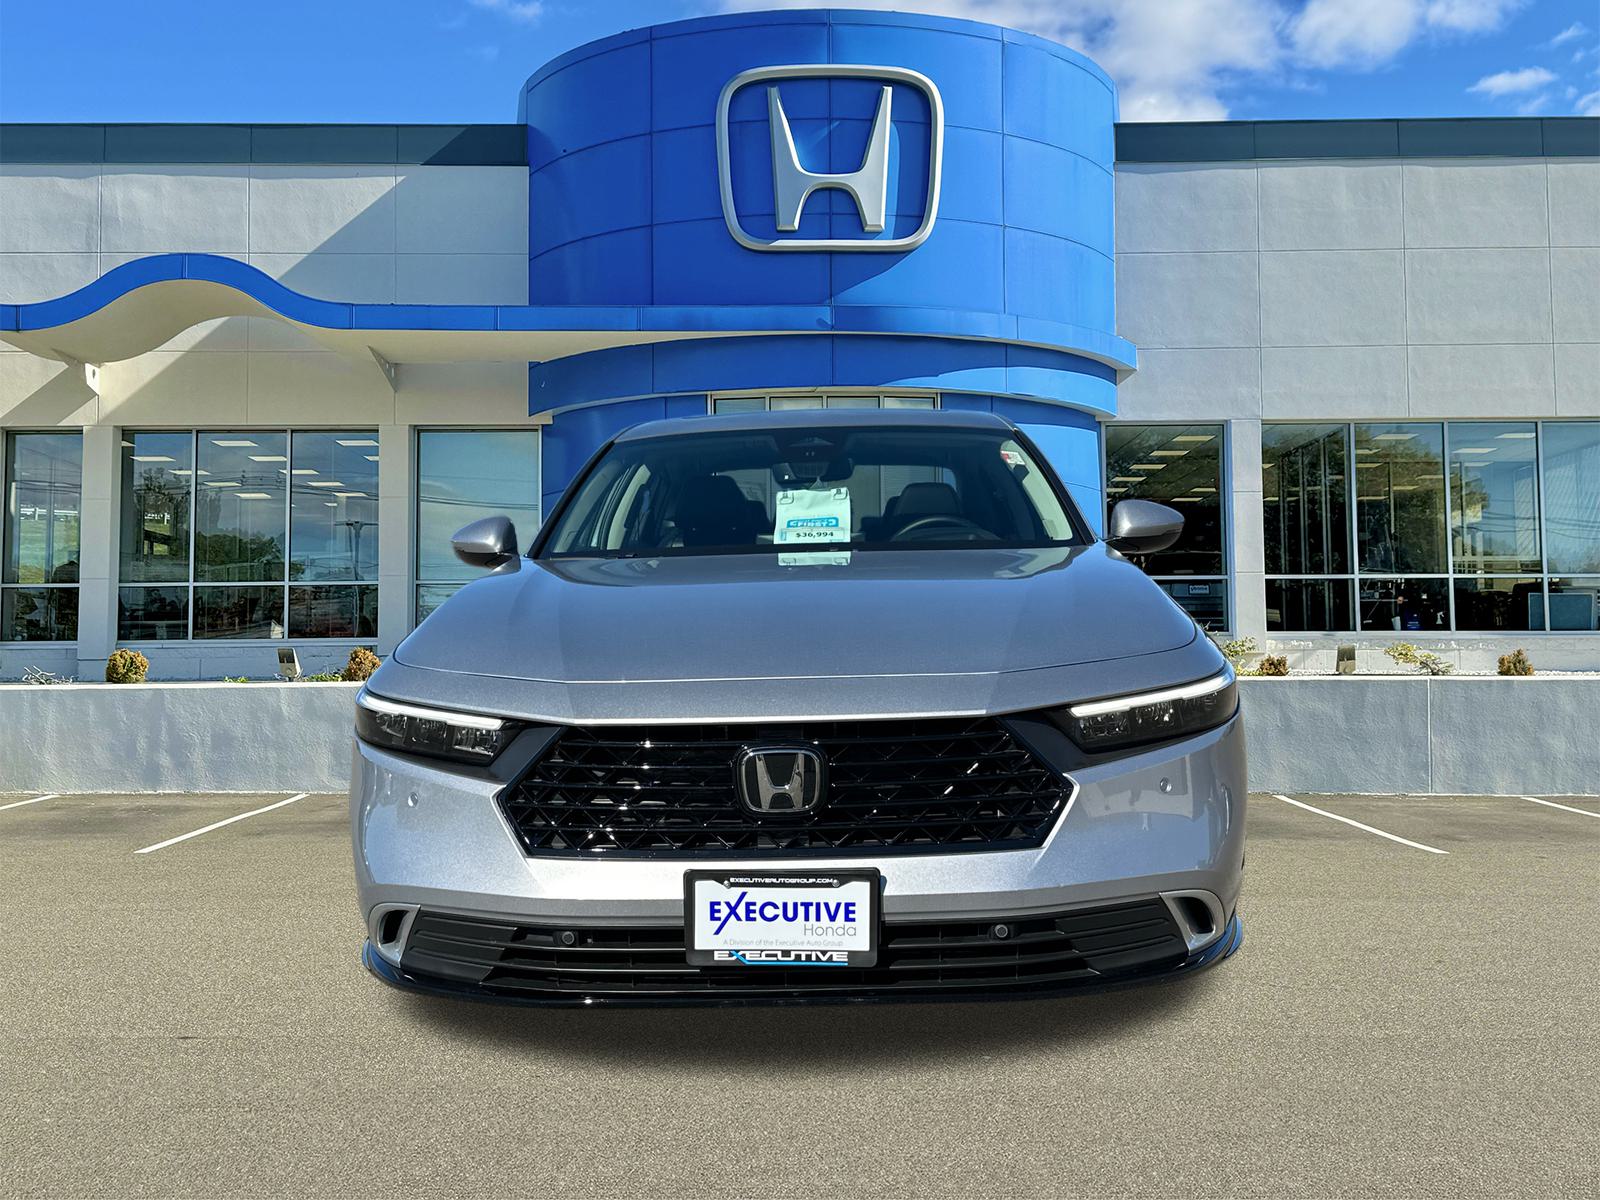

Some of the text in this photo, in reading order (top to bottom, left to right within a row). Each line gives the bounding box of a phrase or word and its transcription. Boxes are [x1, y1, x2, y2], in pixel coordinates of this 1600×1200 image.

[709, 891, 856, 935] EXECUTIVE
[803, 924, 857, 937] Honda
[823, 940, 844, 948] Group
[713, 950, 849, 963] EXECUTIVE
